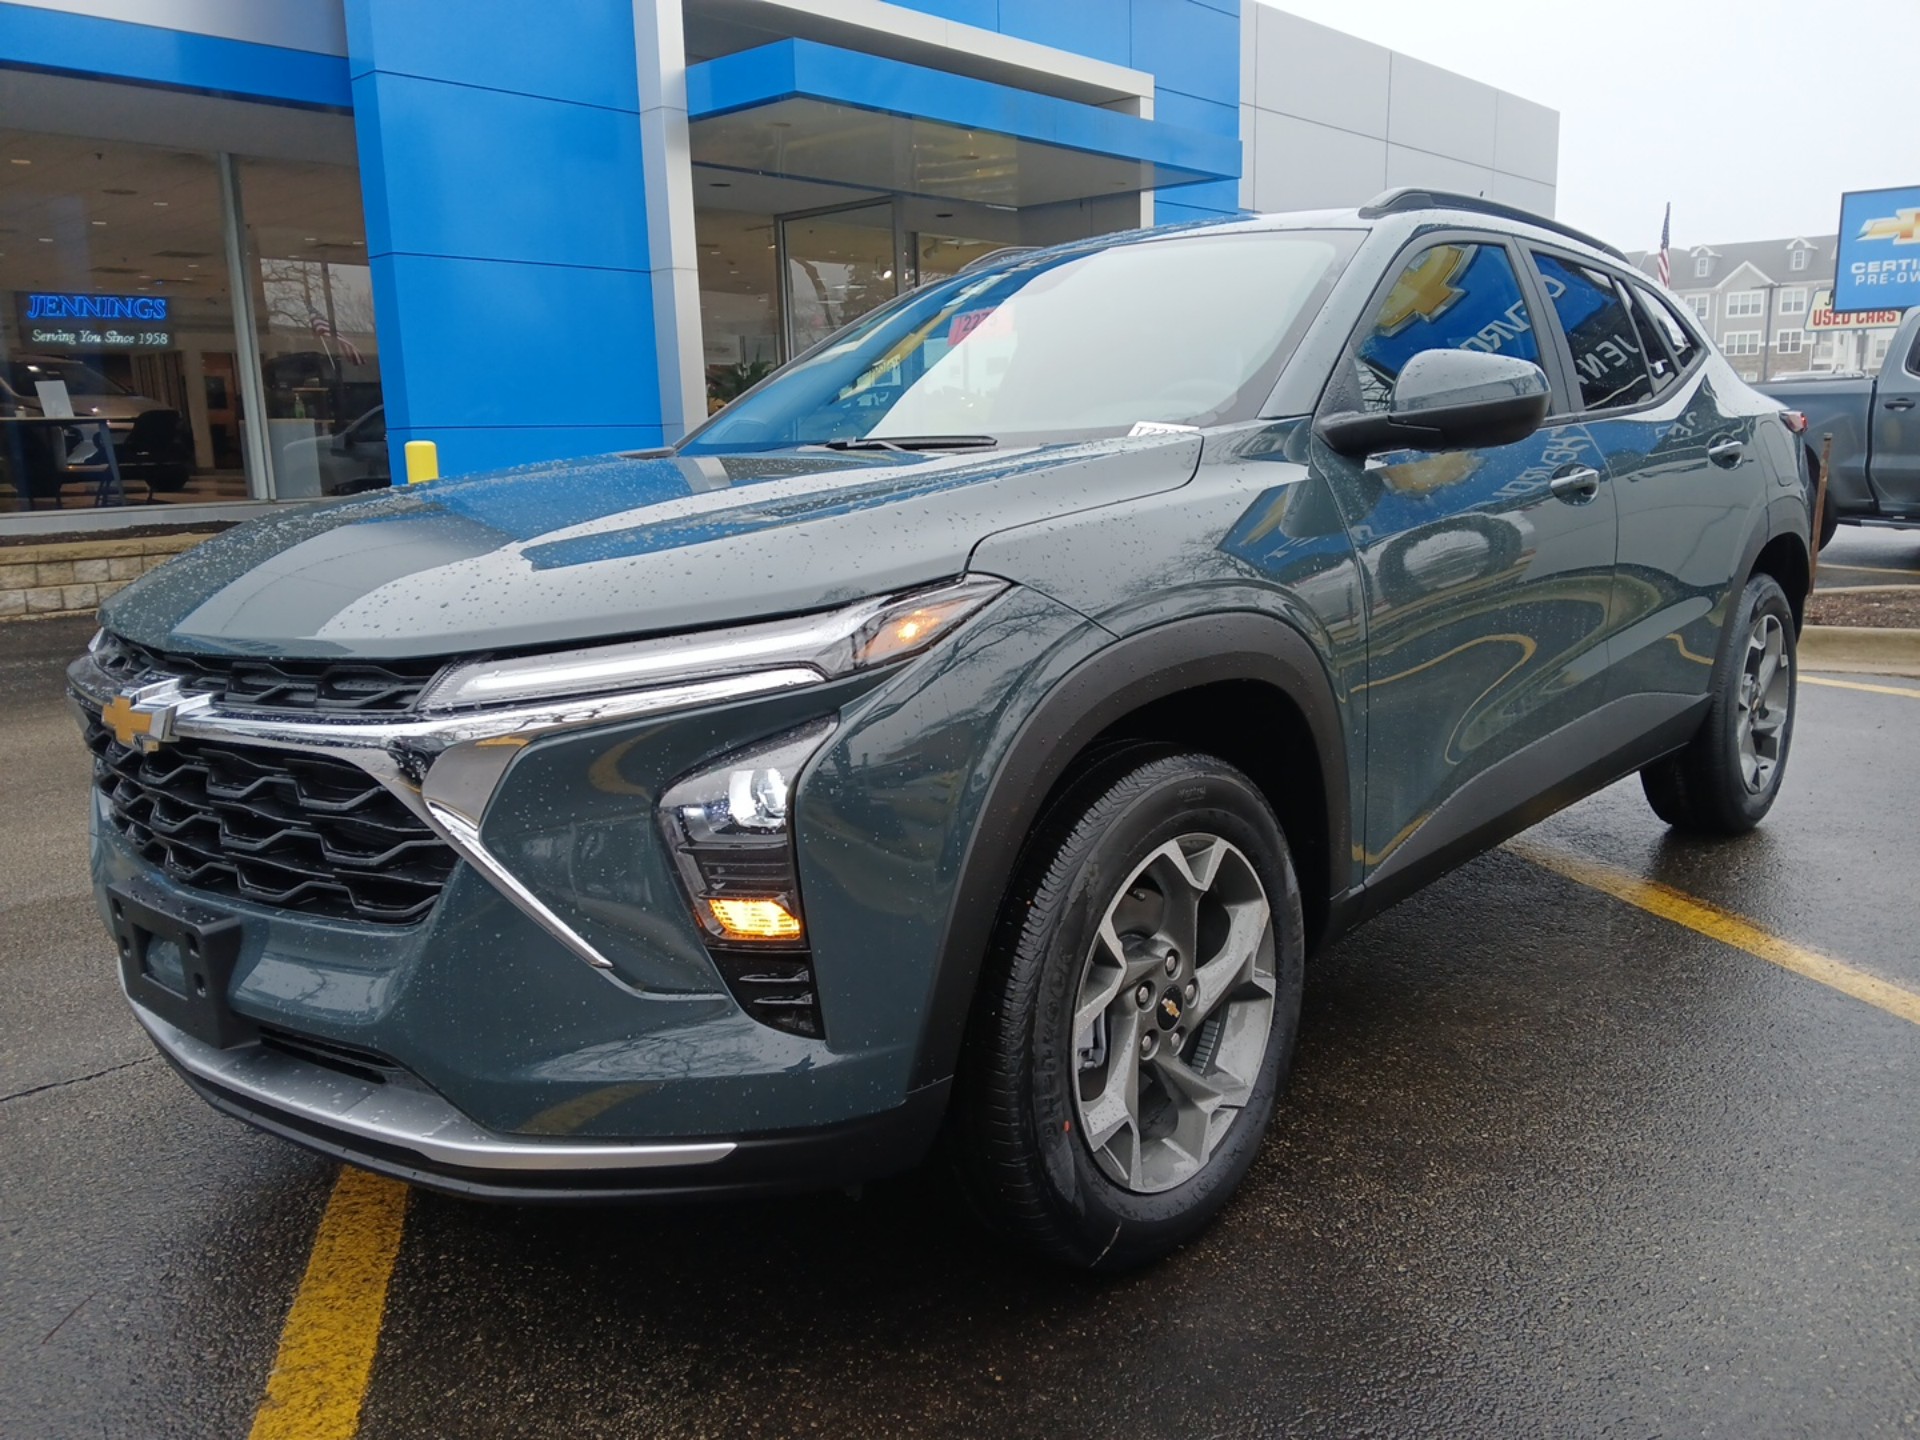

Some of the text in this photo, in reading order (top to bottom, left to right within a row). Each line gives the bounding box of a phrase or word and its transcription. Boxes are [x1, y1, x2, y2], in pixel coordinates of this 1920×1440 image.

[1851, 258, 1920, 274] CERTI
[1855, 271, 1920, 286] PRE-OW
[26, 294, 167, 320] JENNINGS
[1812, 309, 1897, 326] USED CARS
[32, 329, 169, 345] Serving You Since 1958
